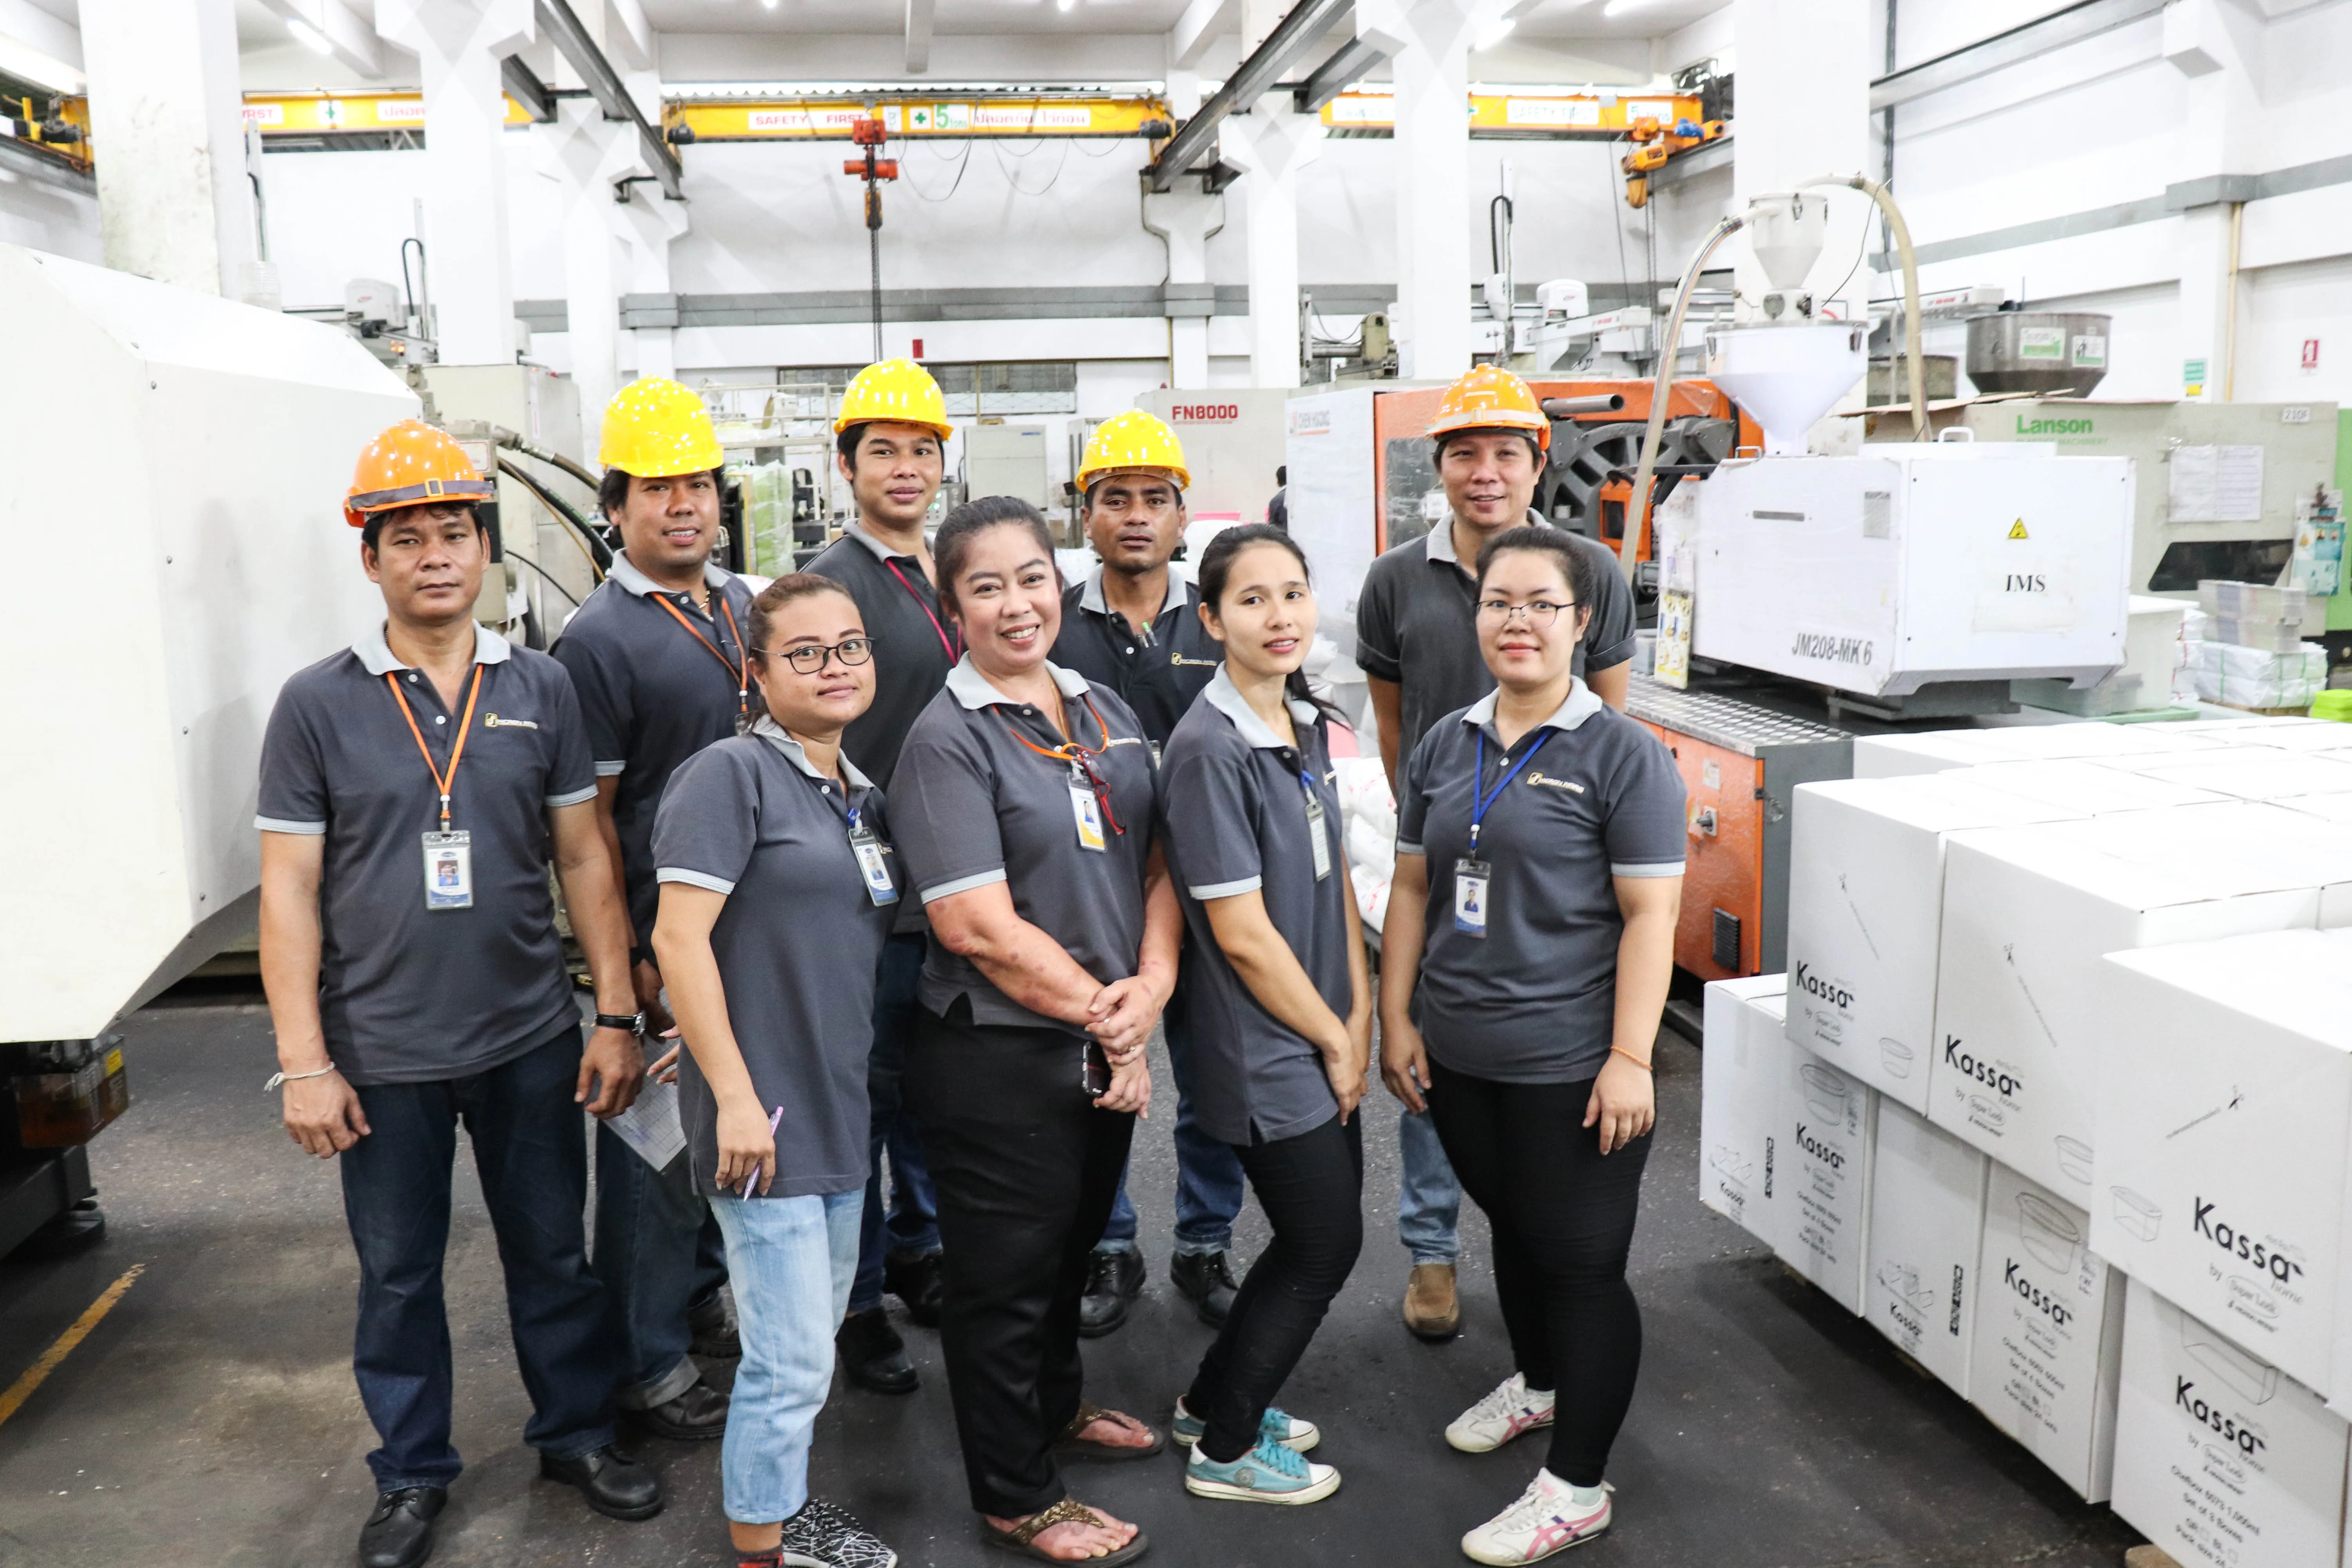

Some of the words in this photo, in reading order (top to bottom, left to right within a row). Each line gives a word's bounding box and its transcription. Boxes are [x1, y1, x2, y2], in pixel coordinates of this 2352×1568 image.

[755, 114, 808, 125] SAFETY
[827, 114, 863, 123] FIRST
[936, 104, 949, 129] 5
[1512, 107, 1555, 118] SAFETY
[1563, 106, 1595, 120] FIRST
[1631, 105, 1639, 119] 5
[1172, 405, 1238, 420] FN8000
[2016, 414, 2094, 434] Lanson
[2005, 574, 2046, 593] IMS
[1791, 633, 1862, 664] JM208-MK
[1864, 641, 1873, 666] 6
[1796, 960, 1855, 1009] Kassa
[1945, 1034, 2022, 1096] Kassa
[1795, 1122, 1846, 1169] Kassa
[2193, 1196, 2305, 1283] Kassa
[2004, 1257, 2073, 1326] Kassa
[2175, 1374, 2268, 1455] Kassa
